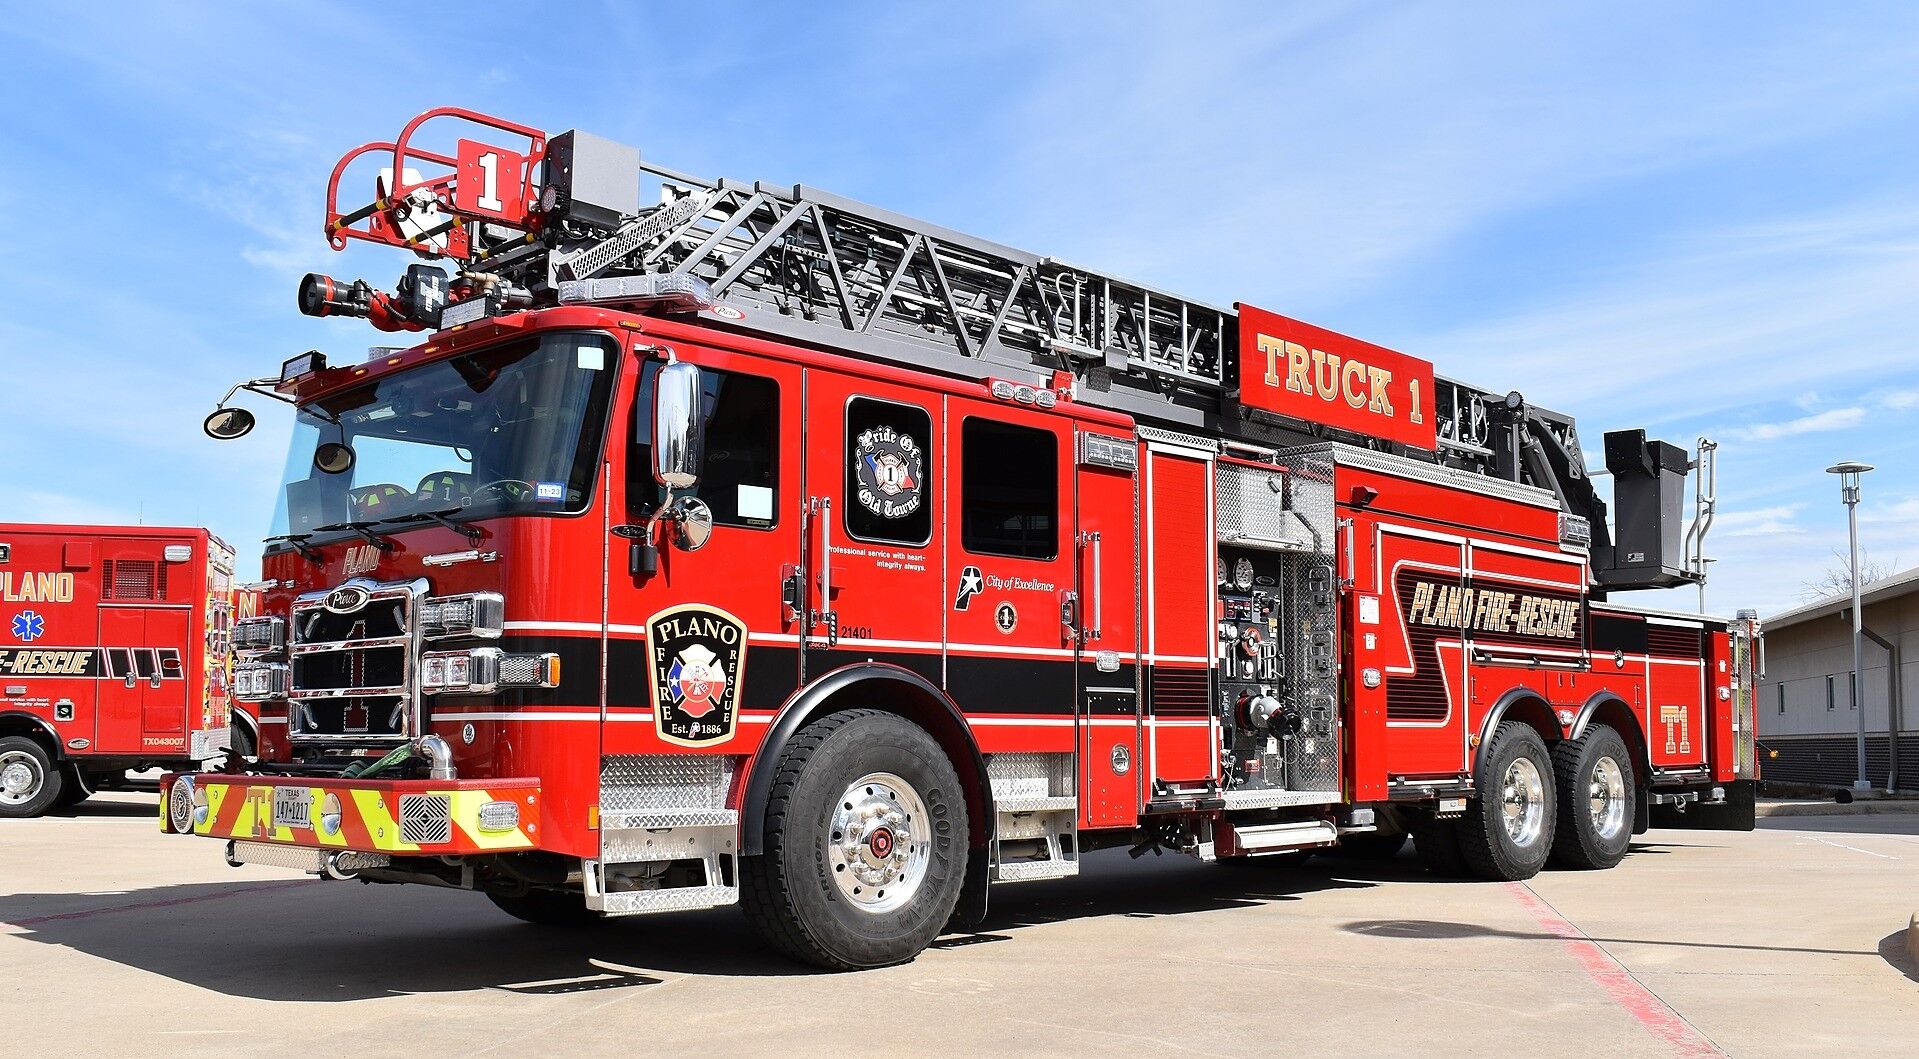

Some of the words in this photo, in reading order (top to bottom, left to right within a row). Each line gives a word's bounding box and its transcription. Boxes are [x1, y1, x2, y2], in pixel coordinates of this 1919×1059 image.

[476, 151, 503, 212] 1
[1257, 333, 1394, 417] TRUCK
[1408, 378, 1423, 425] 1
[858, 426, 897, 452] Pride
[899, 435, 920, 459] Of
[887, 467, 893, 481] 1
[858, 488, 880, 515] Old
[883, 494, 920, 518] Towne
[868, 550, 890, 559] service
[892, 552, 906, 560] with
[877, 560, 902, 570] integrity
[904, 562, 926, 572] always.
[0, 571, 74, 602] LANO
[986, 575, 1004, 590] City
[1004, 577, 1014, 591] of
[1014, 577, 1055, 592] Excellence
[1409, 581, 1475, 629] PLANO
[1473, 589, 1580, 639] FIRE-RESCUE
[657, 616, 738, 645] PLANO
[841, 626, 873, 639] 21401
[656, 647, 672, 721] FIRE
[723, 649, 737, 723] RESCUE
[671, 723, 689, 734] Est.
[701, 724, 722, 734] 1886
[1660, 705, 1691, 755] T1
[285, 789, 300, 798] TEXAS
